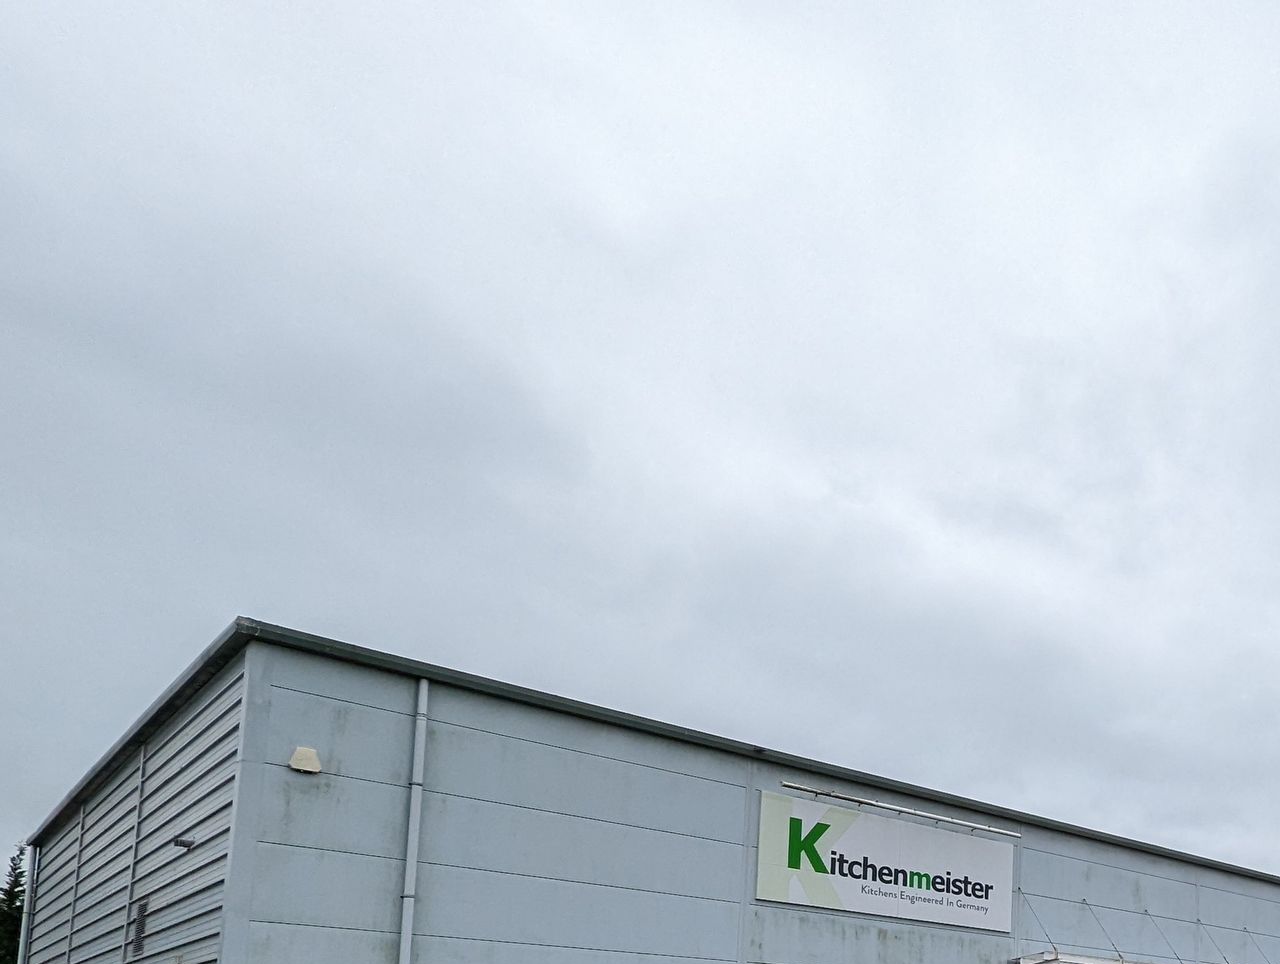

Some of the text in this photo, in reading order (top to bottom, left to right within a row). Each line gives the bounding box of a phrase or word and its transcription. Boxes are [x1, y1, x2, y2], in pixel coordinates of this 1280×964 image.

[787, 816, 994, 900] Kitchenmeister
[860, 884, 989, 915] Kitchens Engineered In Germany
